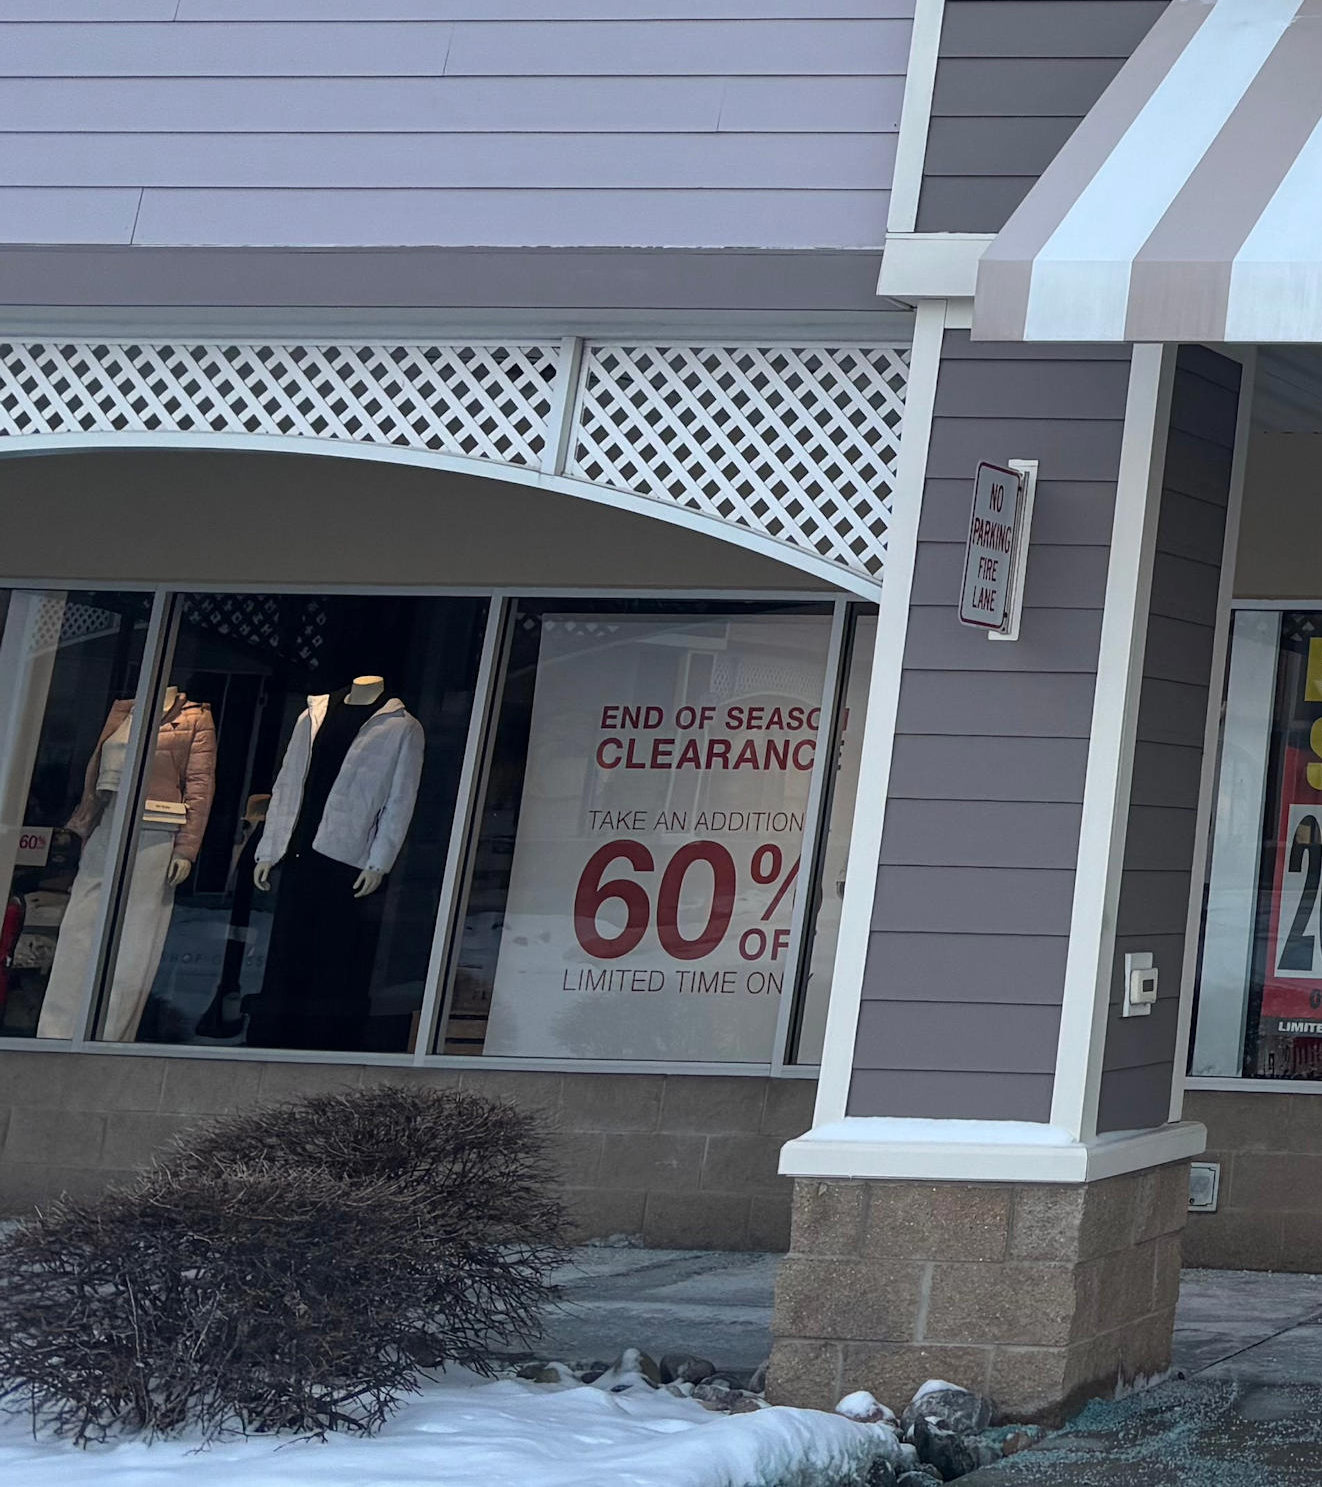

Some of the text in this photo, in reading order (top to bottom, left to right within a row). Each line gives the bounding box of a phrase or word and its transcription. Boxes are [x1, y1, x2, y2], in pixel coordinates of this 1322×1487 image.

[989, 483, 1004, 512] NO
[972, 517, 1012, 554] PARKING
[977, 557, 999, 581] FIRE
[972, 585, 997, 612] LANE
[600, 706, 664, 730] END
[675, 706, 715, 730] OF
[595, 738, 844, 771] CLEARANC
[589, 810, 804, 833] TAKE AN ADDITION
[739, 928, 791, 961] OF
[562, 969, 665, 993] LIMITED
[675, 970, 738, 994] TIME
